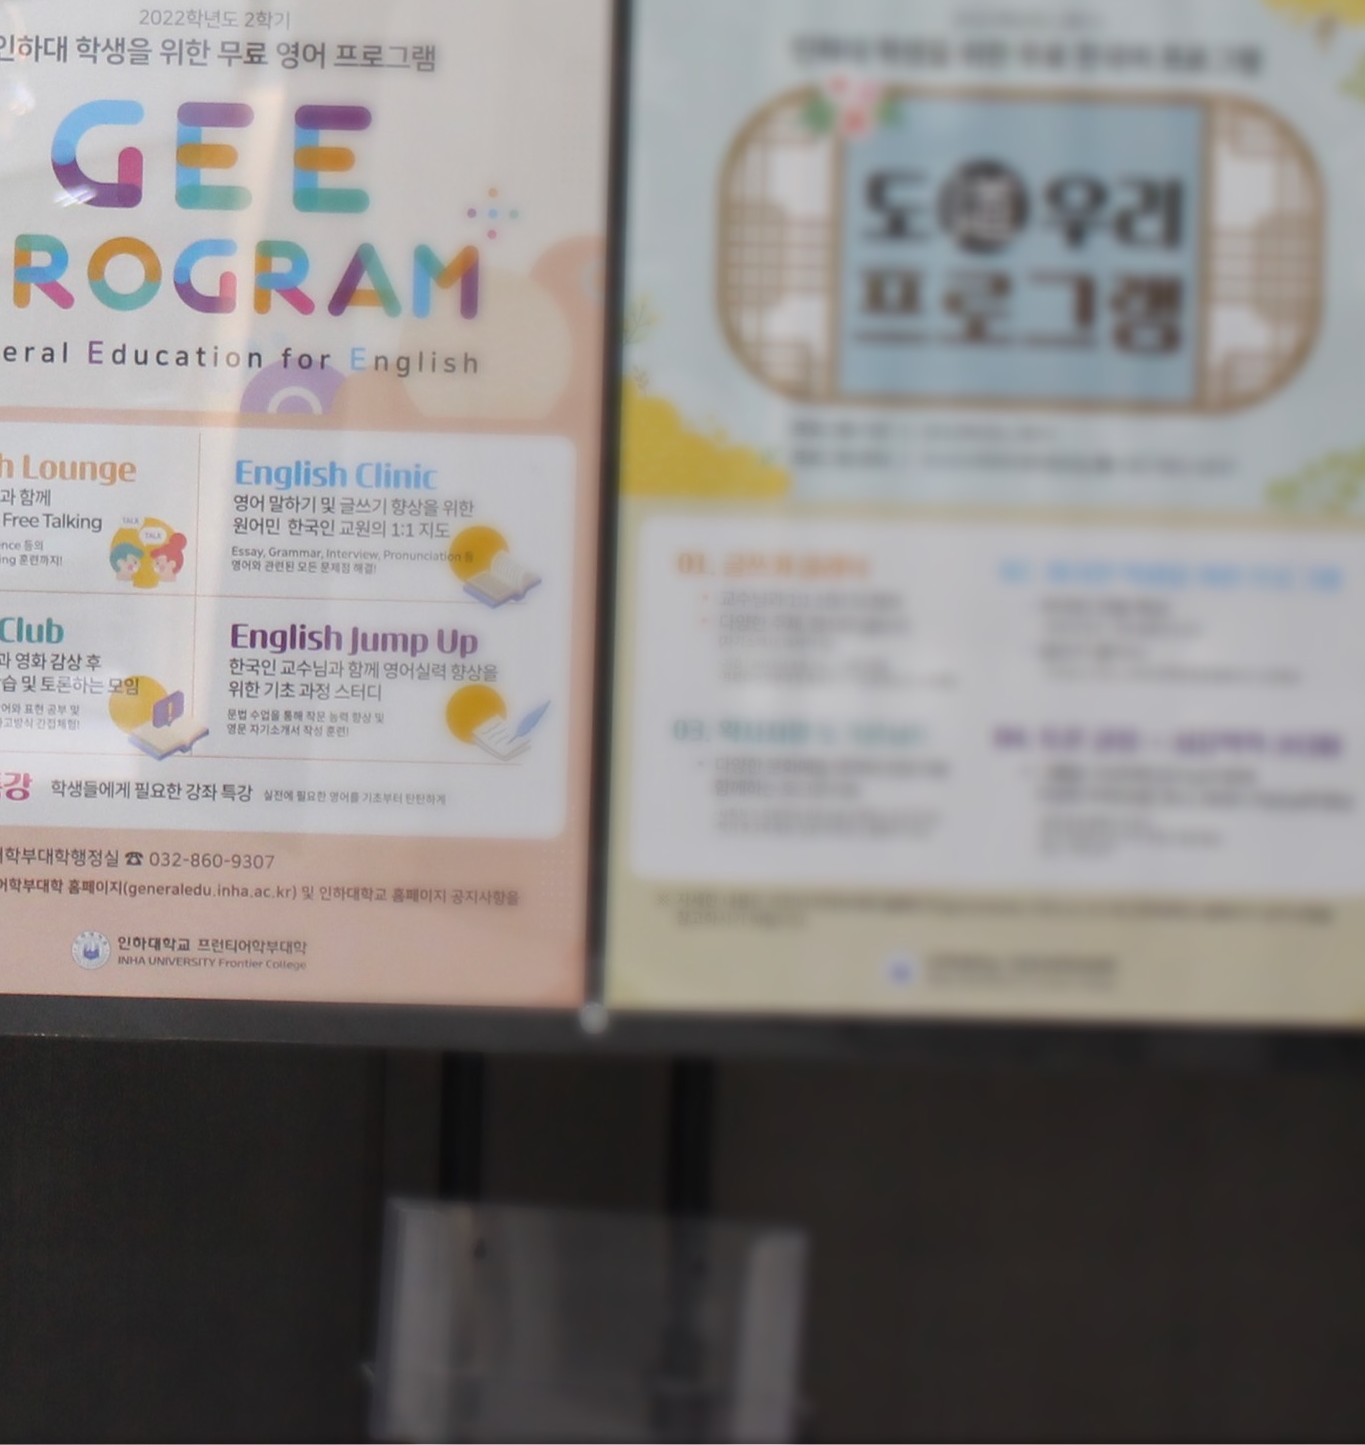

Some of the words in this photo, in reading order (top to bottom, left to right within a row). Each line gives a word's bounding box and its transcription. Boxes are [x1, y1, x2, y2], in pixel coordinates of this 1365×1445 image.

[139, 8, 239, 29] 2022학년도
[245, 10, 290, 30] 2학기
[76, 37, 152, 65] 학생을
[160, 38, 210, 66] 위한
[217, 41, 268, 66] 무료
[276, 42, 326, 69] 영어
[334, 44, 435, 72] 프로그램
[51, 100, 372, 213] GEE
[853, 268, 1185, 356] 프로그램
[88, 341, 263, 368] Education
[281, 348, 331, 370] for
[349, 348, 479, 378] English
[23, 455, 137, 486] Lounge
[235, 459, 347, 491] English
[355, 462, 437, 490] Clinic
[20, 489, 51, 506] 함께
[233, 494, 264, 511] 영어
[269, 495, 317, 513] 말하기
[321, 496, 335, 513] 및
[341, 498, 387, 515] 글쓰기
[391, 499, 439, 517] 향상을
[443, 500, 473, 517] 위한
[3, 513, 39, 528] Free
[43, 513, 102, 533] Talking
[233, 517, 280, 535] 원어민
[288, 518, 335, 537] 한국인
[339, 521, 387, 538] 교원의
[419, 521, 450, 539] 지도
[20, 555, 63, 567] 훈련까지!
[232, 547, 264, 559] Essay,
[269, 547, 322, 559] Grammar,
[327, 549, 381, 561] Interview,
[384, 550, 461, 562] Pronunciation
[232, 561, 261, 571] 영어와
[265, 562, 295, 573] 관련된
[231, 623, 342, 653] English
[348, 627, 429, 657] Jump
[437, 629, 478, 659] Up
[15, 653, 47, 671] 영화
[51, 653, 81, 671] 감상
[85, 655, 101, 671] 후
[229, 659, 277, 676] 한국인
[281, 660, 344, 677] 교수님과
[349, 661, 379, 679] 함께
[383, 663, 446, 681] 영어실력
[451, 663, 498, 682] 향상을
[22, 675, 36, 693] 및
[41, 676, 103, 694] 토론하는
[108, 677, 139, 695] 모임
[229, 681, 259, 699] 위한
[264, 682, 295, 699] 기초
[299, 683, 330, 700] 과정
[335, 683, 381, 701] 스터디
[250, 724, 299, 736] 자기소개서
[51, 780, 130, 799] 학생들에게
[135, 782, 182, 800] 필요한
[186, 784, 215, 801] 강좌
[219, 784, 251, 802] 특강
[363, 792, 403, 805] 기초부터
[149, 852, 274, 868] 032-860-9307
[320, 887, 387, 902] 인하대학교
[392, 888, 446, 903] 홈페이지
[451, 889, 518, 905] 공지사항을
[118, 936, 189, 951] 인하대학교
[198, 938, 308, 955] 프런티어학부대학
[119, 957, 145, 966] INHA
[149, 957, 216, 968] UNIVERSITY
[219, 959, 262, 969] Frontier
[266, 960, 306, 971] College
